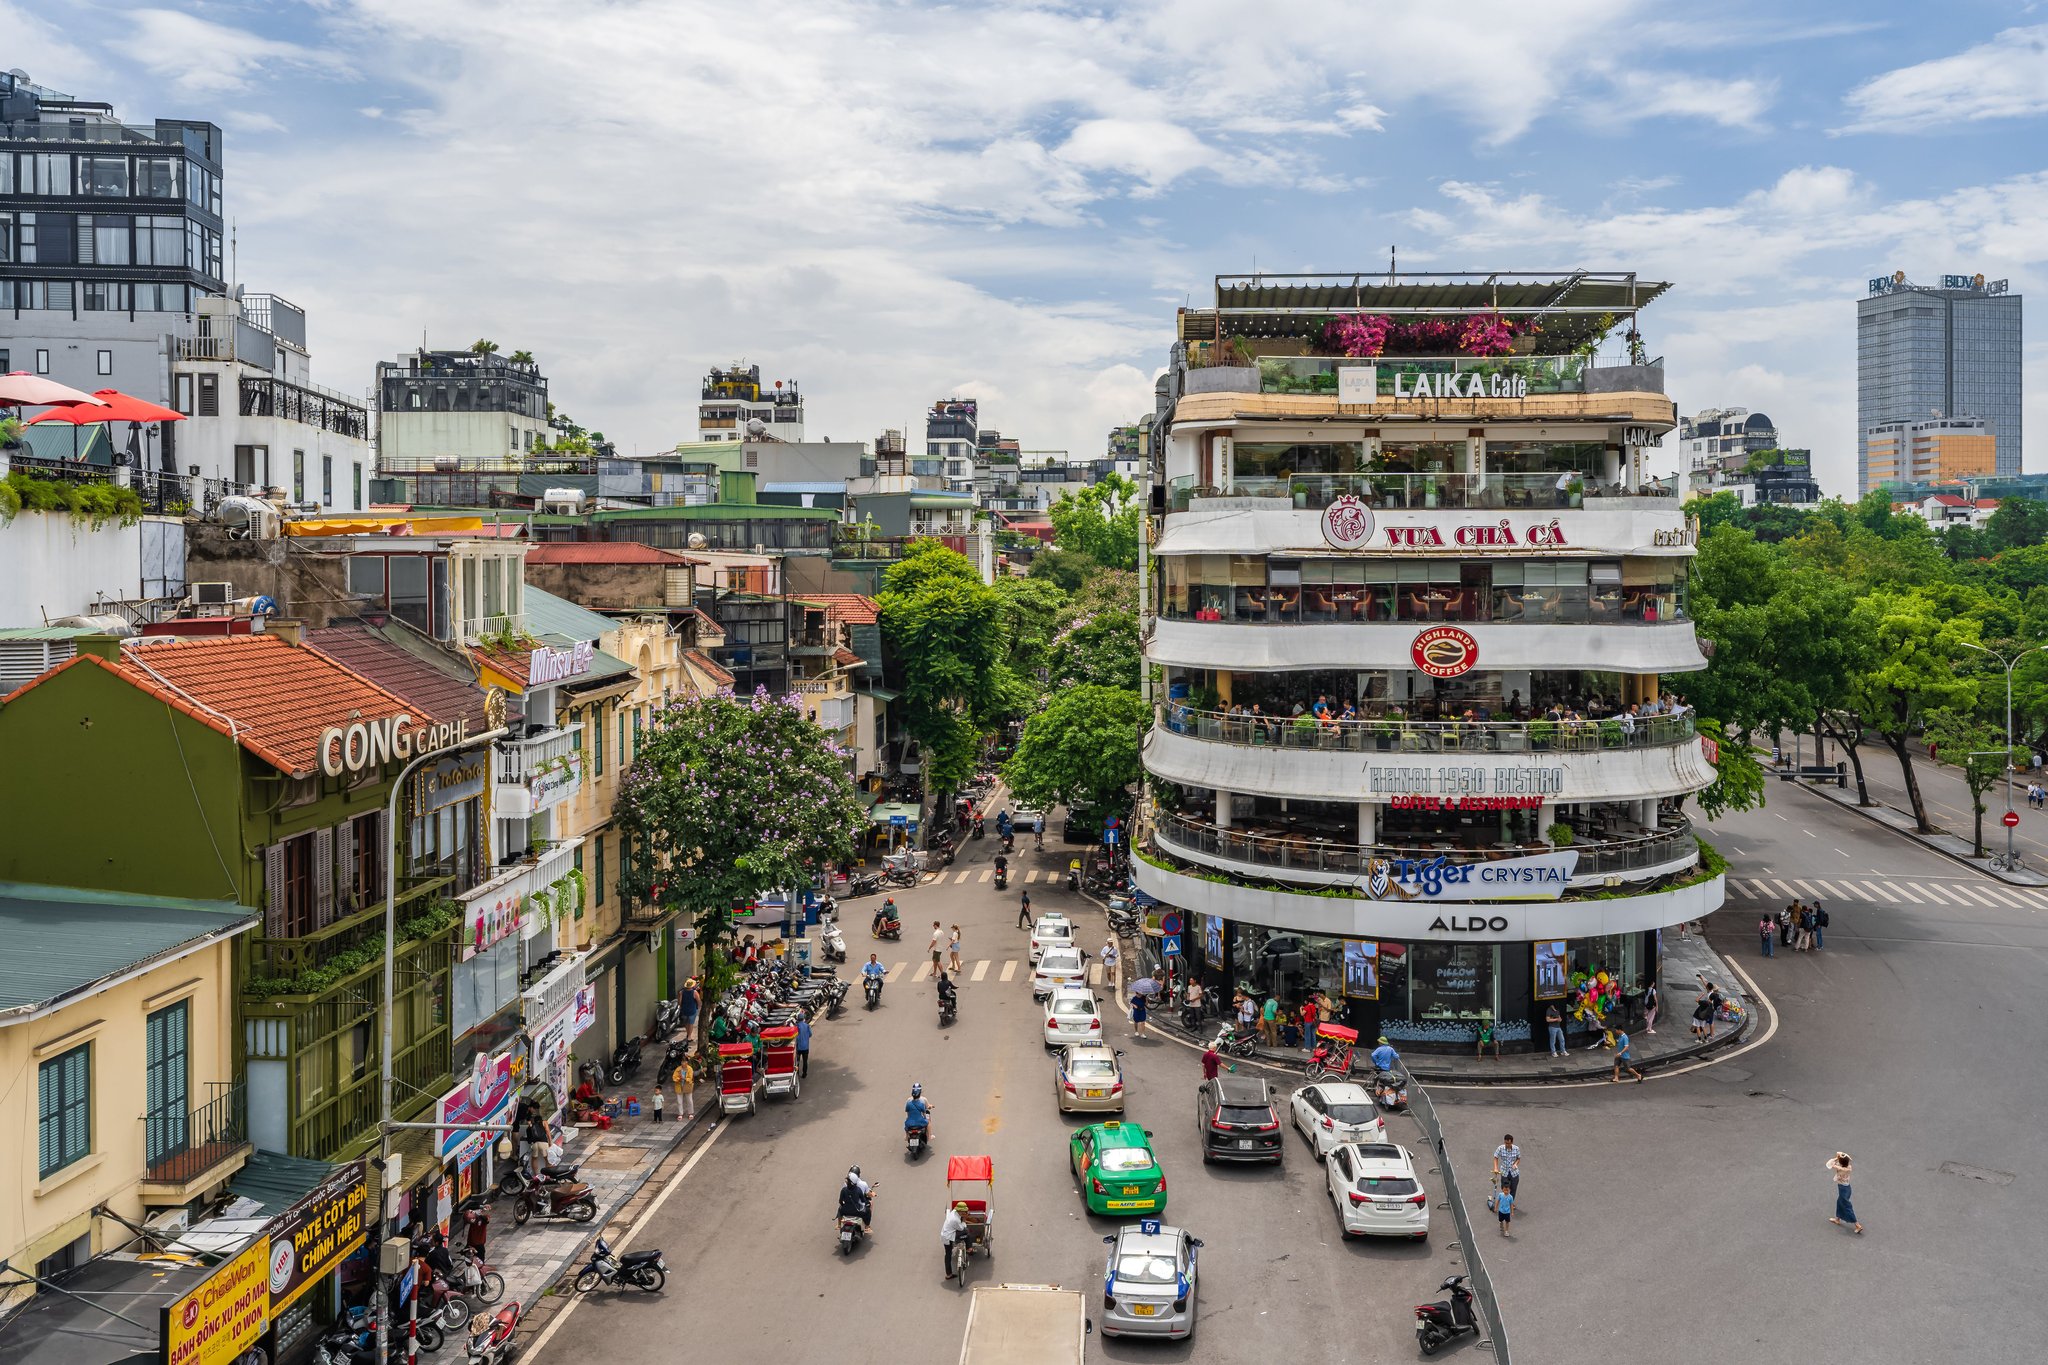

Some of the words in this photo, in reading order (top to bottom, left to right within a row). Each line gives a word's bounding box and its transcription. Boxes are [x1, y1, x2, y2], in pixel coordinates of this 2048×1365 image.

[1869, 275, 1895, 292] BIDV
[1945, 275, 1974, 288] BIDV
[1395, 373, 1486, 398] LAIKA
[1491, 373, 1527, 398] Café
[1623, 427, 1655, 447] LAIKA
[1384, 526, 1446, 547] VUA
[1454, 518, 1518, 547] CHẢ
[1526, 519, 1568, 547] CÁ
[1415, 630, 1475, 651] HIGHLANDS
[1423, 662, 1469, 676] COFFEE
[1370, 768, 1431, 793] HANOI
[1439, 768, 1486, 793] 1930
[1494, 768, 1563, 793] BISTRO
[1391, 797, 1440, 810] COFFEE
[1445, 797, 1455, 810] &
[1460, 796, 1545, 810] RESTAURANT
[1394, 855, 1475, 896] Tiger
[1481, 867, 1572, 883] CRYSTAL
[1429, 916, 1508, 931] ALDO
[294, 1216, 322, 1253] PATE
[323, 1199, 346, 1228] CỘT
[347, 1182, 368, 1211] ĐÈN
[1145, 1222, 1156, 1233] G7
[302, 1234, 334, 1274] CHÍNH
[337, 1213, 361, 1246] HIỆU
[275, 1250, 289, 1275] HBL
[203, 1261, 255, 1310] CheeWon
[171, 1335, 195, 1365] BÁNH
[196, 1316, 220, 1348] ĐỒNG
[221, 1306, 233, 1328] XU
[252, 1279, 268, 1305] MAI
[231, 1323, 242, 1341] 10
[243, 1304, 263, 1331] WON
